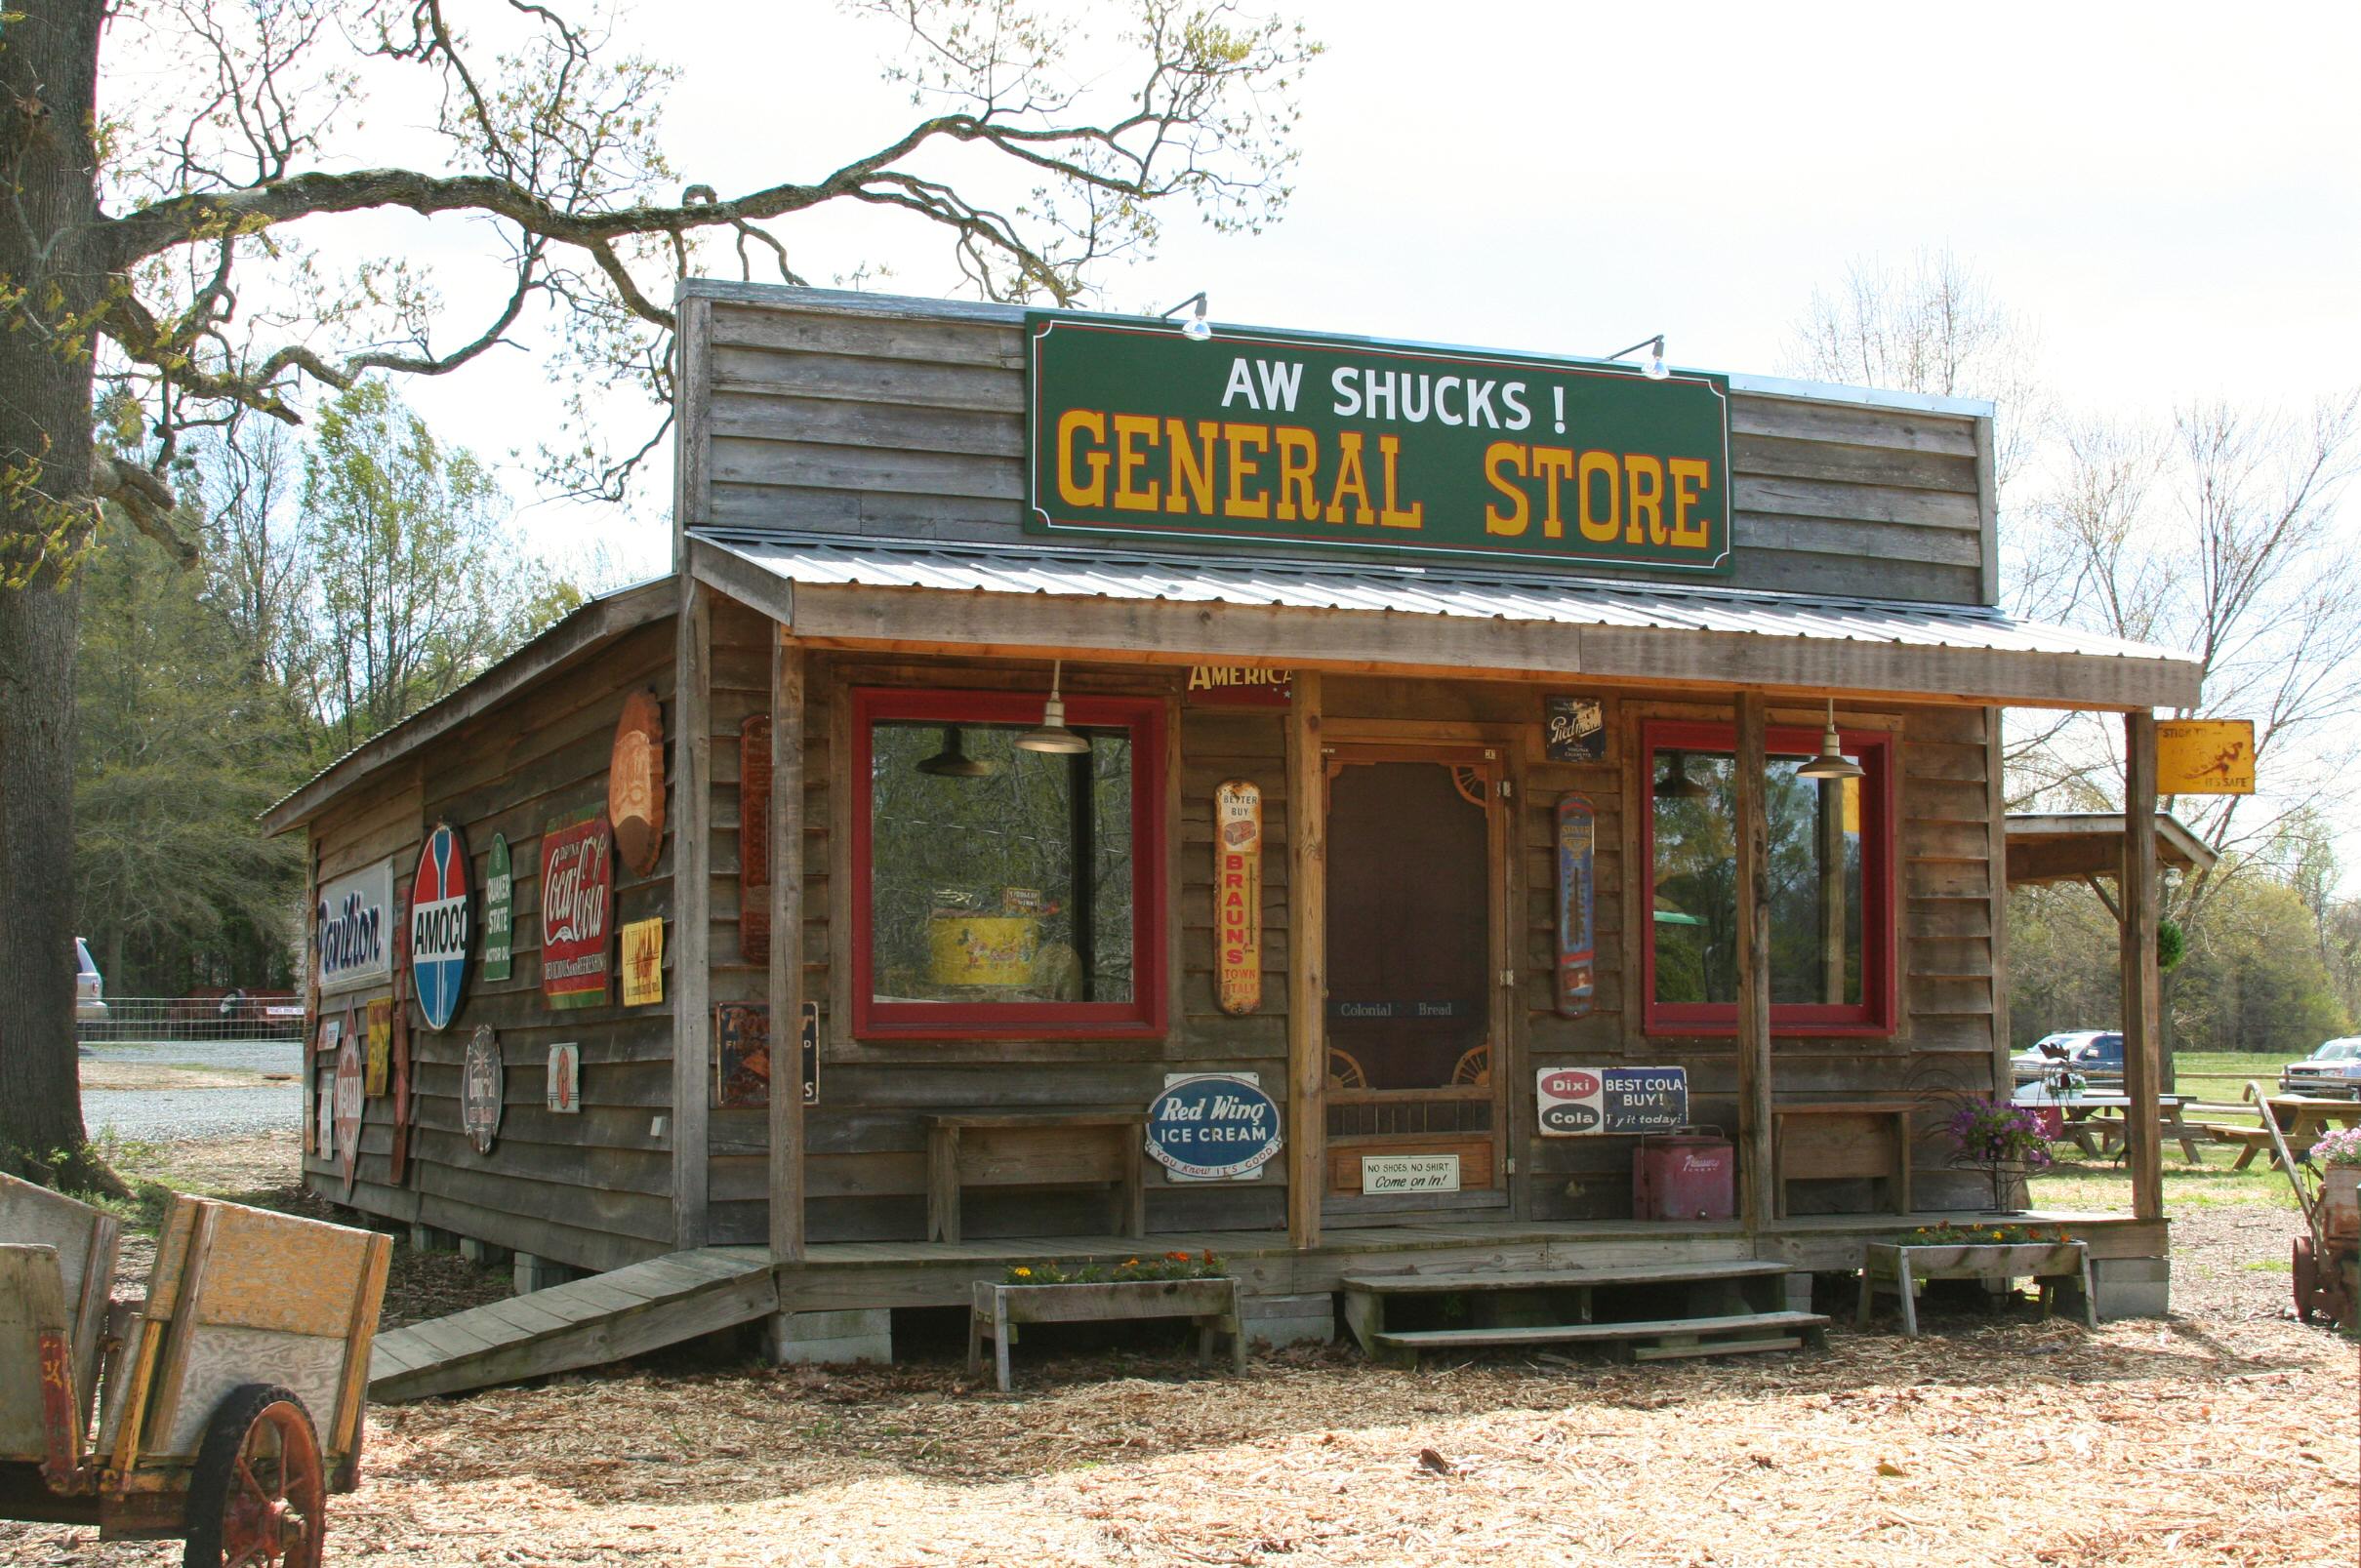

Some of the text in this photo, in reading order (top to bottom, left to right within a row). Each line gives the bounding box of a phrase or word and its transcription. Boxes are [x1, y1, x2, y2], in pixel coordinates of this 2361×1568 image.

[1222, 357, 1303, 413] AW
[1332, 366, 1531, 431] SHUCKS
[1056, 408, 1711, 549] GENERAL STORE
[1551, 709, 1603, 744] Piedmt
[2223, 778, 2249, 787] SAFE
[1224, 794, 1258, 805] BETTER
[1232, 807, 1249, 817] BUY
[488, 906, 509, 935] STATE
[414, 904, 468, 955] AMOCO
[1225, 968, 1256, 980] TOWN
[1341, 1002, 1452, 1016] Colonial Bread
[1553, 1079, 1589, 1091] Dixi
[1606, 1078, 1683, 1091] BEST COLA
[1160, 1095, 1267, 1125] Red Wing
[1551, 1111, 1594, 1124] Cola
[1607, 1114, 1624, 1127] Ty
[1626, 1114, 1637, 1124] it
[1161, 1127, 1267, 1143] ICE CREAM
[1156, 1149, 1177, 1168] YOU
[1244, 1147, 1274, 1168] GOOD
[1367, 1164, 1380, 1173] NO
[1411, 1163, 1423, 1172] NO
[1375, 1176, 1407, 1188] Come
[1410, 1177, 1426, 1186] on
